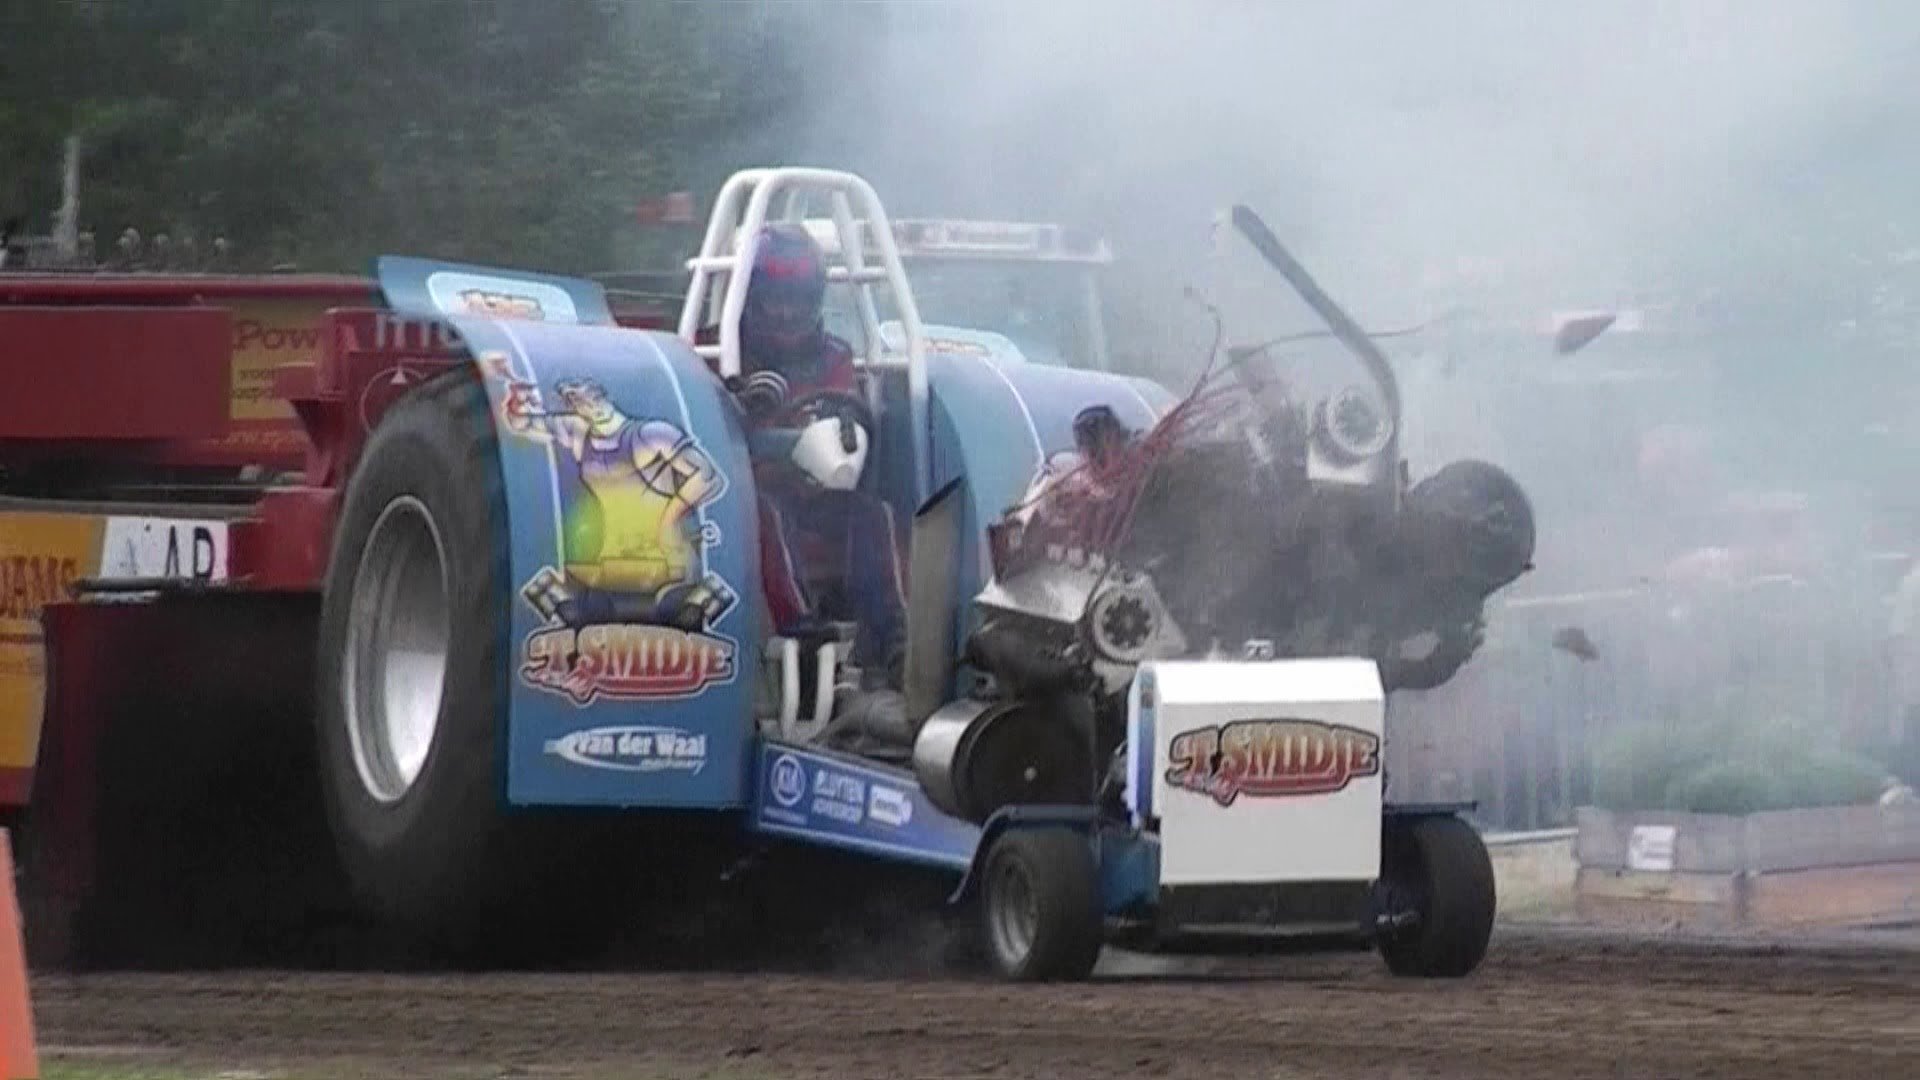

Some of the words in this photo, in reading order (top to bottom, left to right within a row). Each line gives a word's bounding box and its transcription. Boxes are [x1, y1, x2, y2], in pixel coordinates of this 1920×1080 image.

[618, 732, 651, 756] der
[655, 733, 706, 757] Waal
[1212, 719, 1378, 801] SMIDJE
